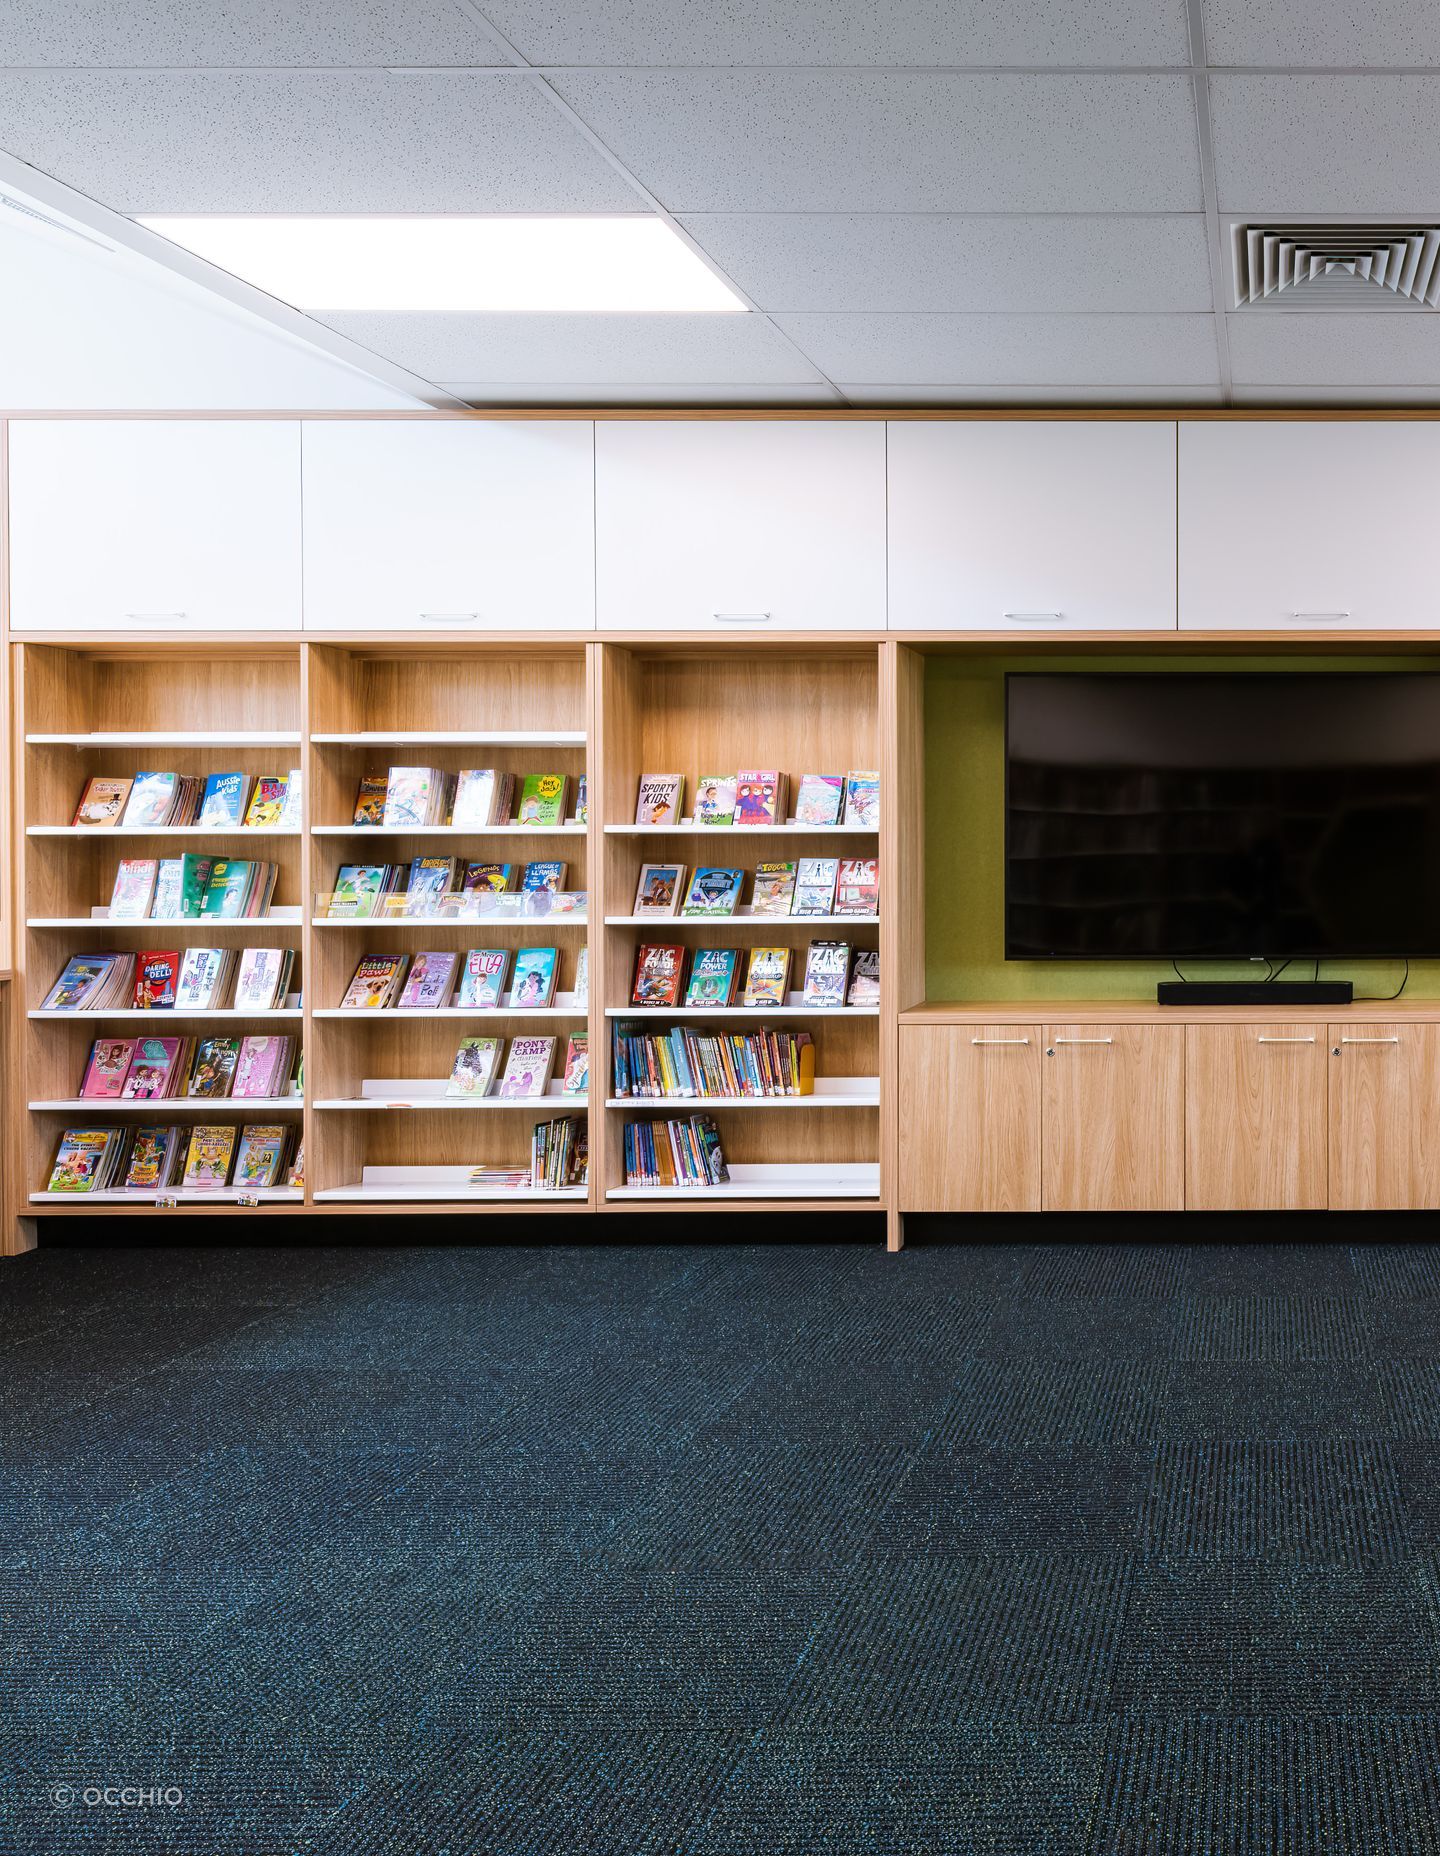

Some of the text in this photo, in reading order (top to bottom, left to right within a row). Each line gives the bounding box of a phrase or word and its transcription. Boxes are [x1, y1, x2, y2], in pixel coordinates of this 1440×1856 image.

[740, 773, 757, 781] STAR
[641, 783, 677, 793] SPORTY
[643, 793, 670, 804] KIDS
[840, 861, 876, 877] ZAC
[646, 948, 675, 961] ZAC
[702, 951, 729, 963] ZAC
[811, 948, 847, 966] ZAC
[857, 952, 880, 966] ZA
[145, 962, 170, 974] DARING
[361, 961, 392, 970] Little
[470, 953, 503, 975] ELLA
[700, 962, 727, 970] POWER
[150, 968, 173, 979] DELLY
[359, 968, 391, 978] paws
[516, 1039, 547, 1048] PONY
[514, 1047, 546, 1056] CAMP
